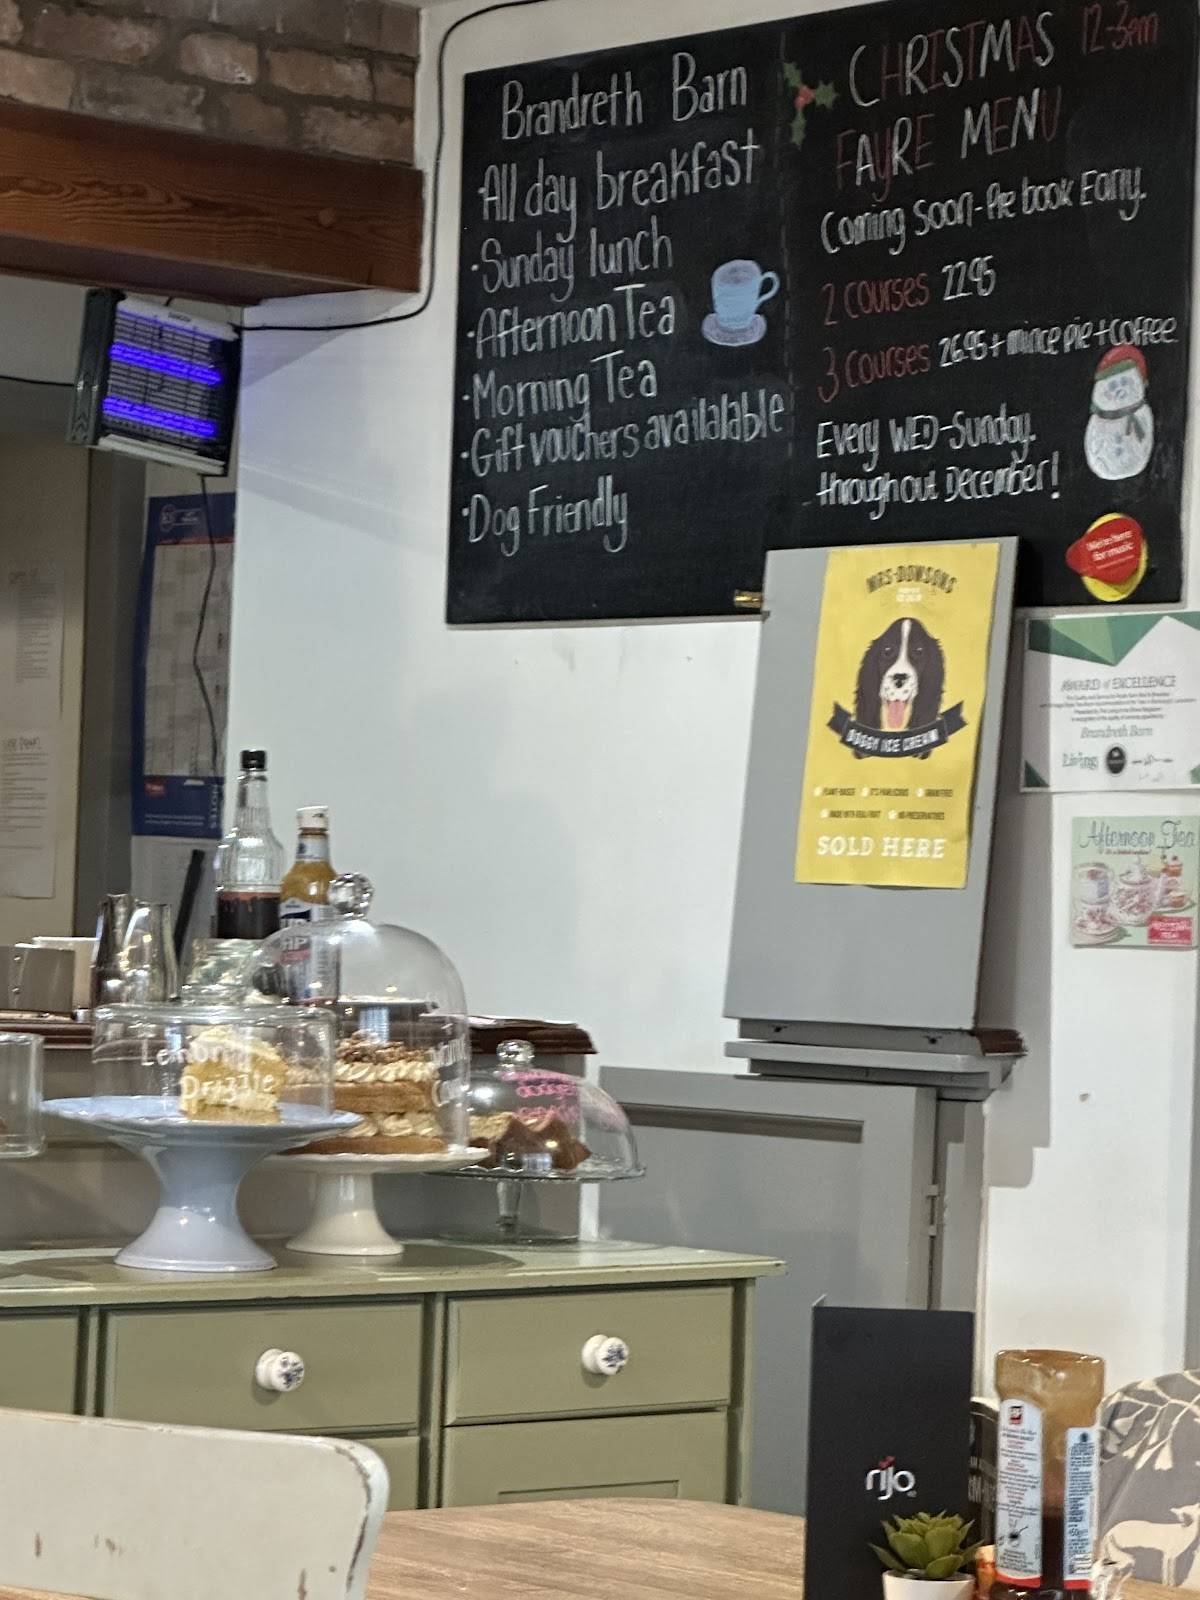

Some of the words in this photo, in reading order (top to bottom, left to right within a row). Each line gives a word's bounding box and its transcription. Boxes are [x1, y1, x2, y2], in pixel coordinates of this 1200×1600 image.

[850, 11, 1054, 106] CHRISTMAS
[502, 72, 643, 139] Brandreth
[672, 52, 747, 121] Barn
[961, 87, 1062, 159] MENU
[483, 163, 517, 222] All
[524, 158, 577, 242] day
[596, 128, 761, 210] breakfast
[821, 204, 906, 256] Coming
[1022, 177, 1074, 214] book
[481, 230, 574, 302] Sunday
[590, 215, 672, 277] lunch
[477, 303, 617, 359] Afternoon
[613, 284, 675, 340] Tea
[822, 284, 837, 326] 2
[472, 369, 590, 423] Morning
[591, 350, 658, 403] Tea
[818, 346, 839, 403] 3
[471, 422, 525, 477] Gift
[530, 421, 640, 466] vouchers
[816, 419, 879, 472] Every
[469, 493, 520, 557] Dog
[528, 475, 629, 552] Friendly
[881, 737, 901, 752] ICE
[817, 836, 874, 856] SOLD
[880, 837, 947, 858] HERE
